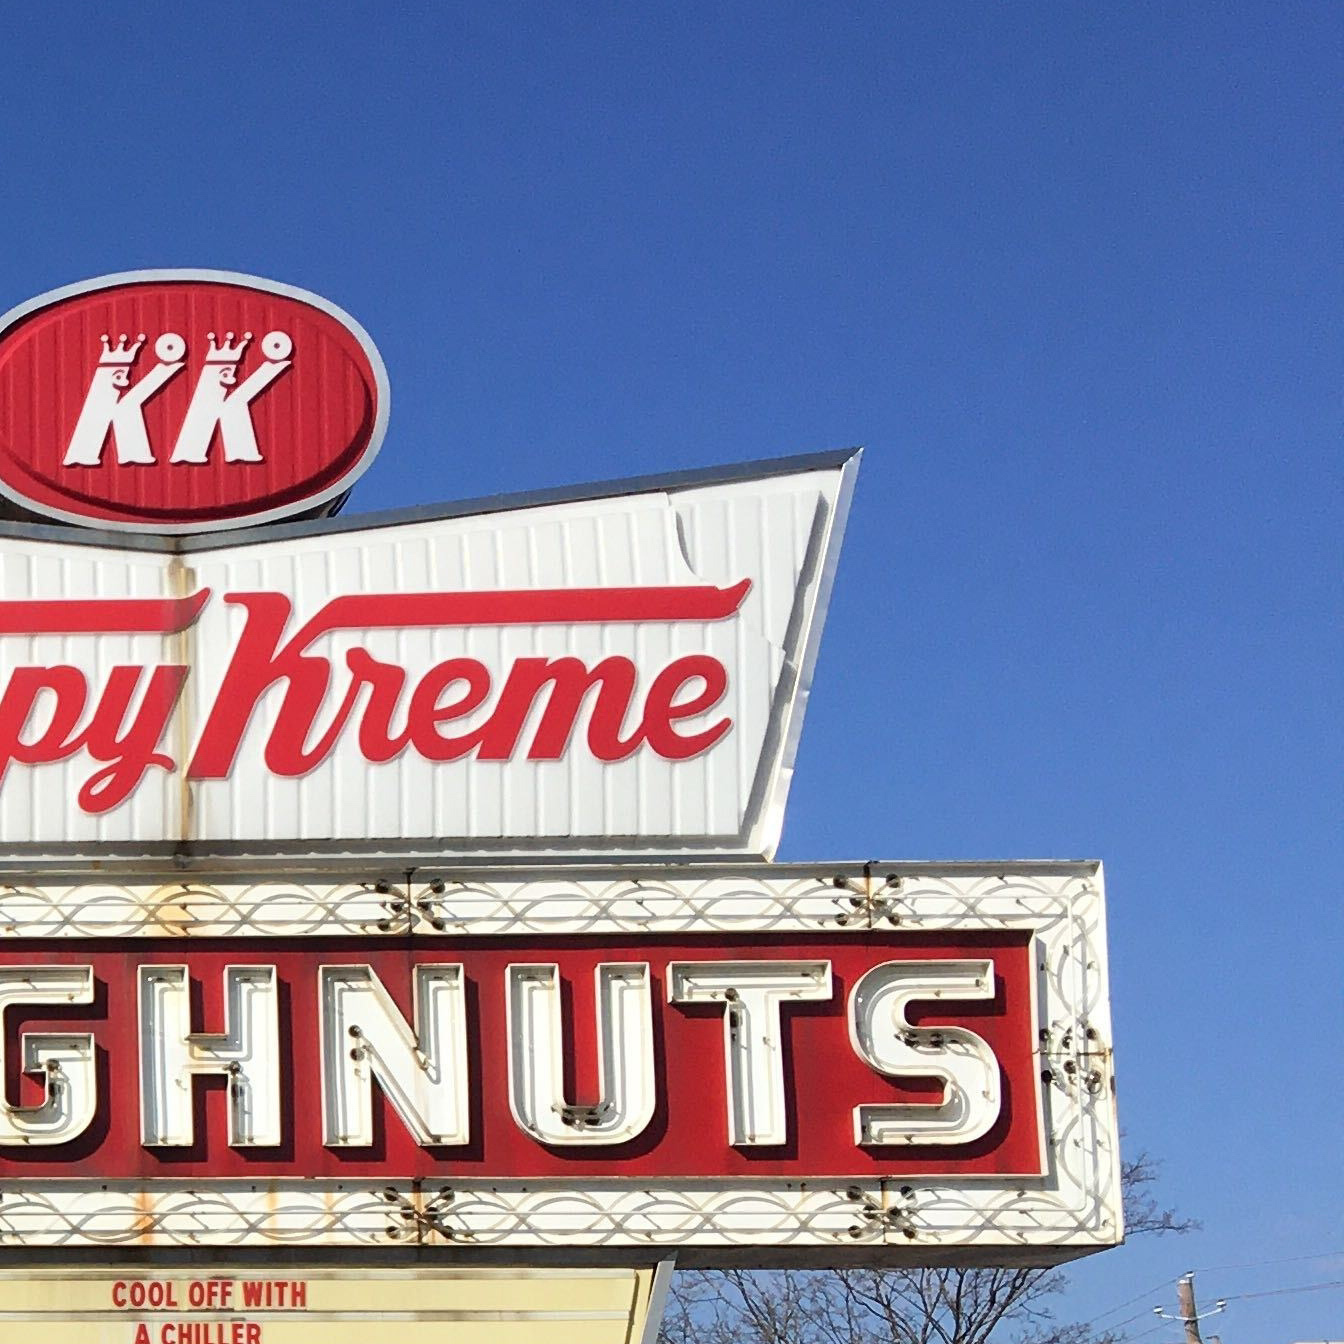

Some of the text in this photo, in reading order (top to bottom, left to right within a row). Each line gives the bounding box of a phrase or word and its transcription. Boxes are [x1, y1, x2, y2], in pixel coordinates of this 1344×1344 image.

[188, 577, 753, 782] Kreme
[112, 1281, 307, 1307] COOL OFF WITH
